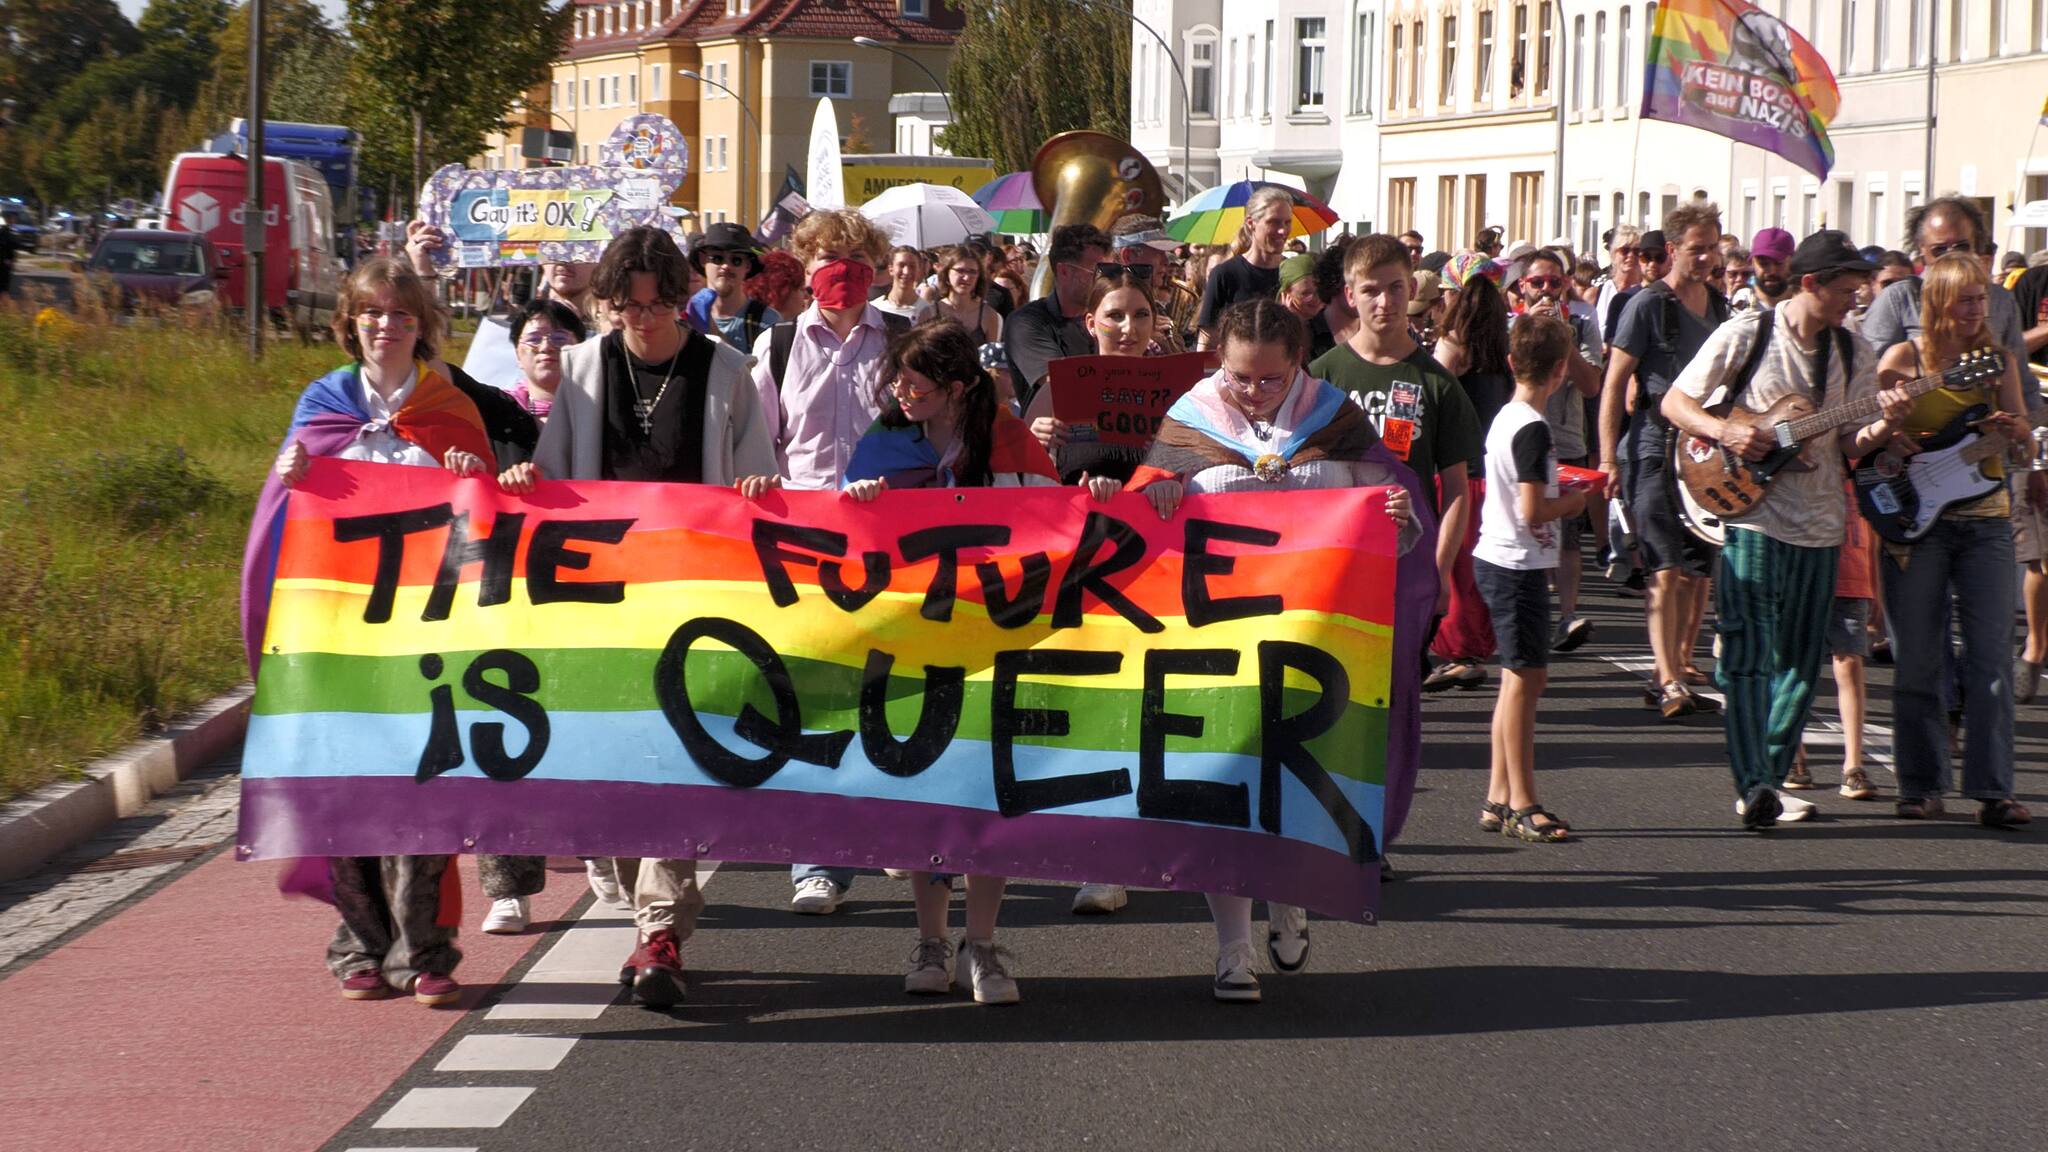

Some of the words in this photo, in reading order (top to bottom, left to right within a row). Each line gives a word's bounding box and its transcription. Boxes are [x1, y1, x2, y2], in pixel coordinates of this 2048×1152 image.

[1683, 64, 1744, 93] KEIN
[1705, 90, 1737, 111] auf
[1739, 95, 1807, 138] NAZIS
[228, 201, 280, 227] dd
[470, 198, 509, 231] Gay
[516, 202, 538, 223] it's
[333, 502, 638, 624] THE
[654, 616, 1381, 865] QUEER
